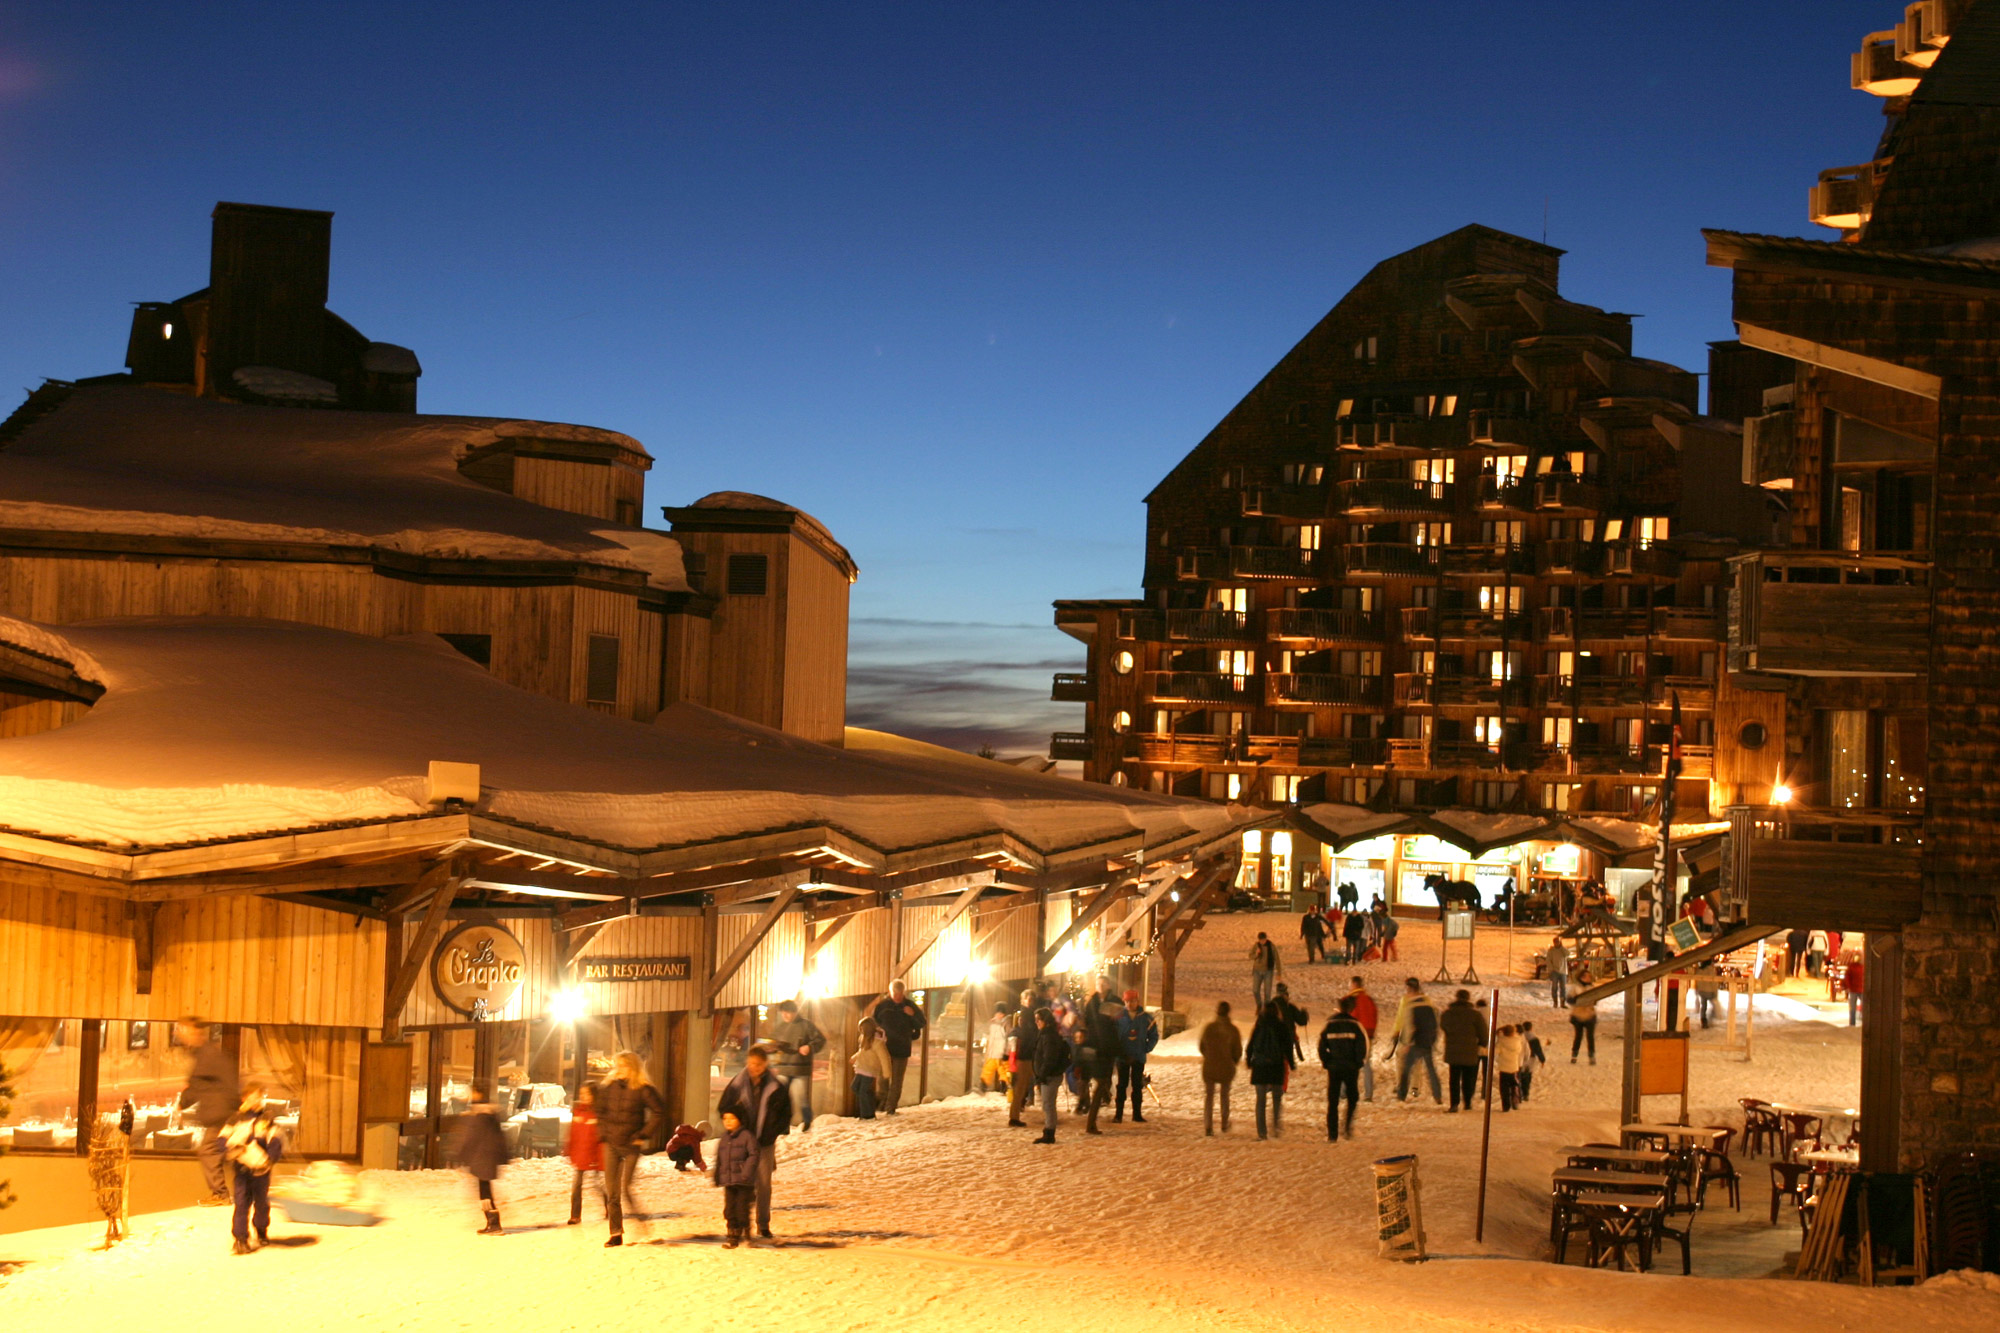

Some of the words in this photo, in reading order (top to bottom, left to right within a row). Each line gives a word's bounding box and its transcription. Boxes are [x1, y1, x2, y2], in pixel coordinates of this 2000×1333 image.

[471, 937, 495, 964] Le
[445, 948, 521, 991] Chapka
[585, 964, 609, 978] BAR
[612, 963, 687, 978] RESTAURANT
